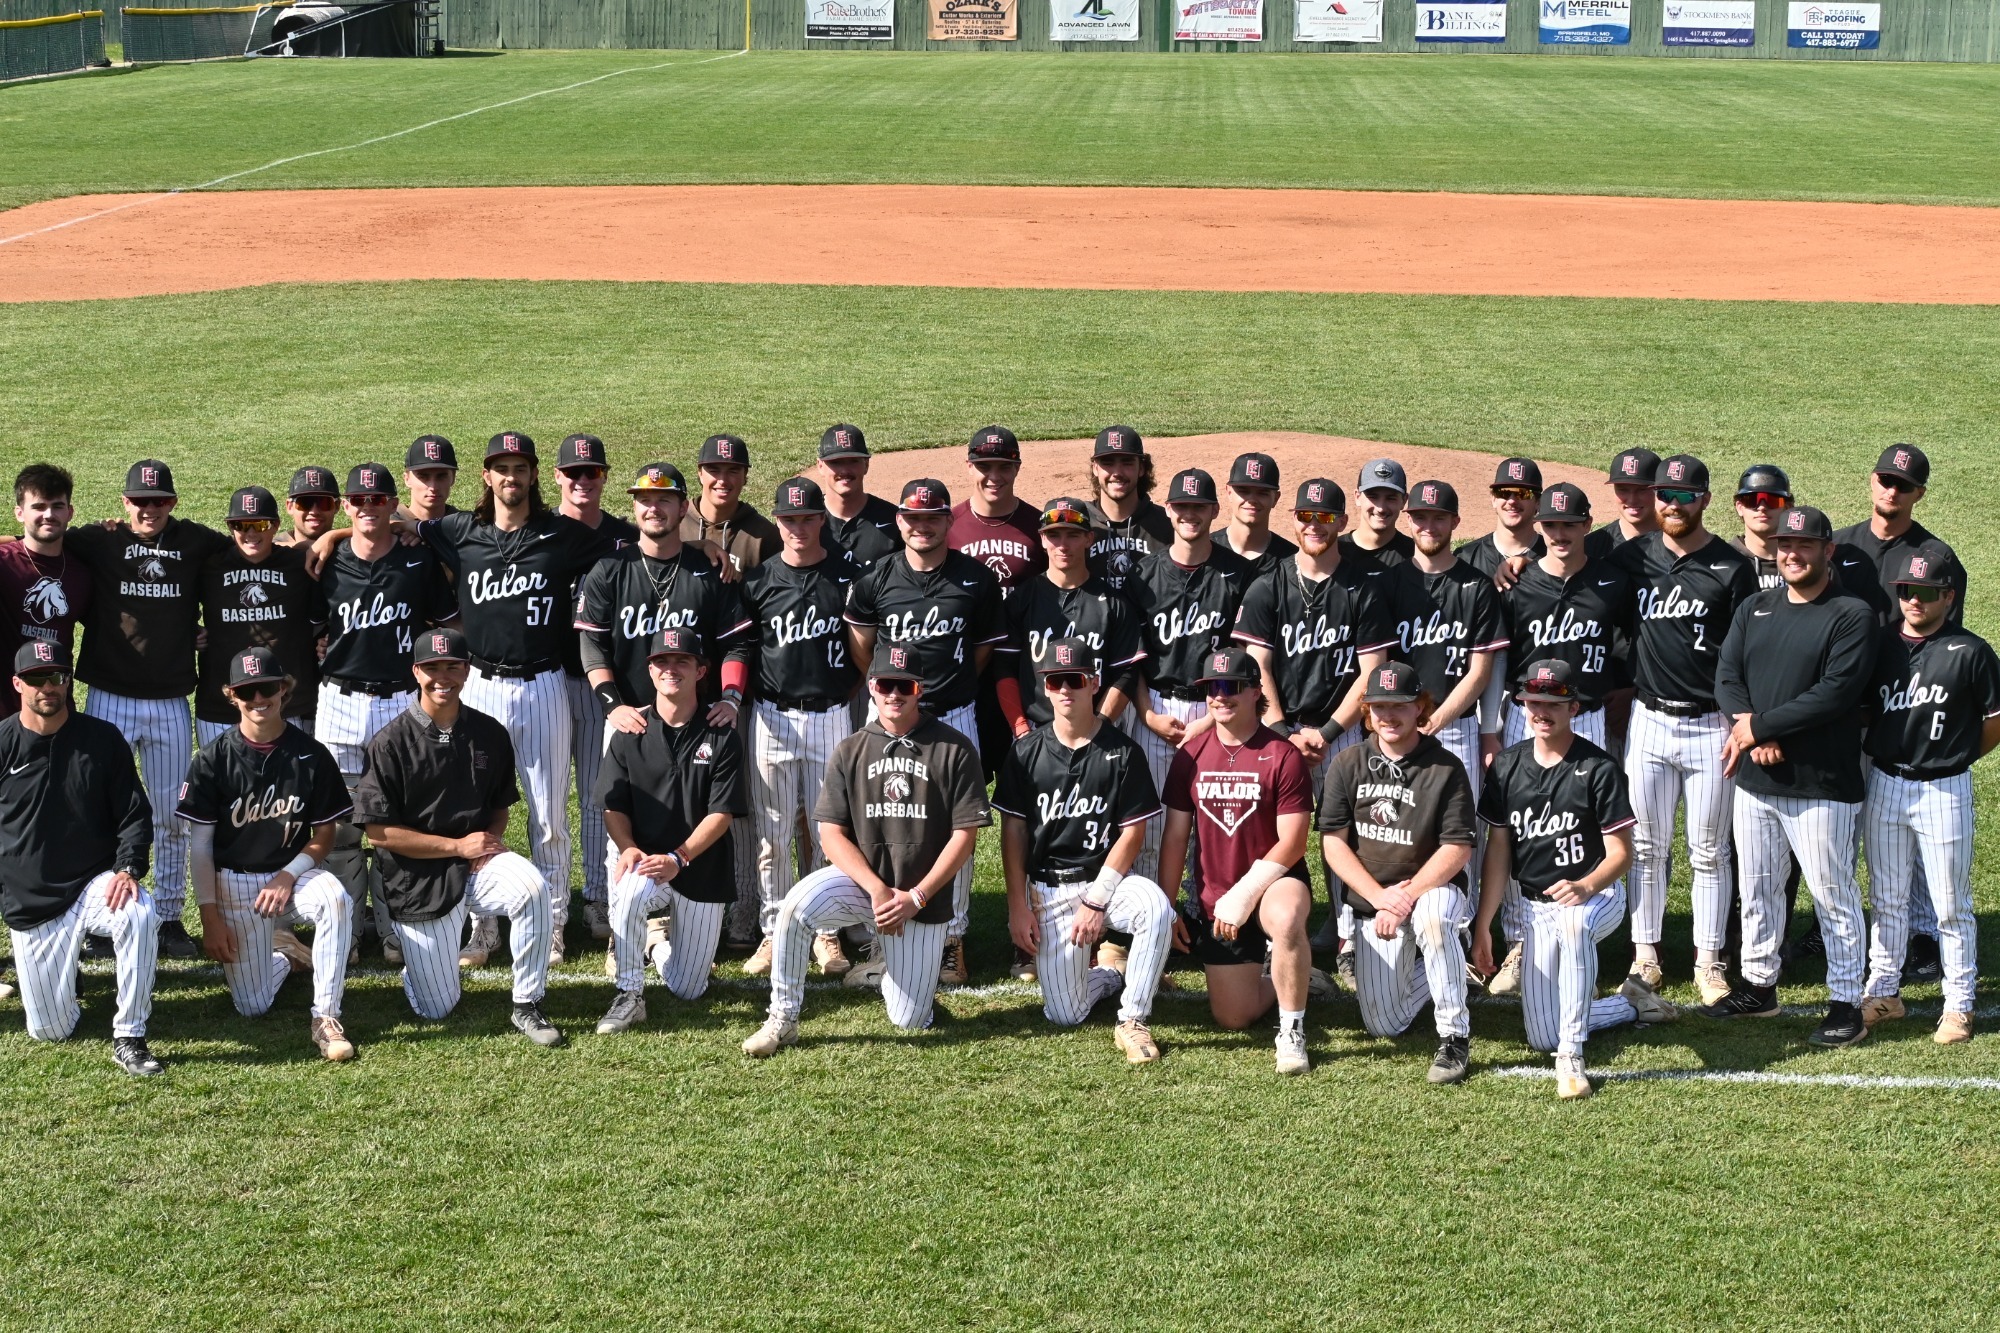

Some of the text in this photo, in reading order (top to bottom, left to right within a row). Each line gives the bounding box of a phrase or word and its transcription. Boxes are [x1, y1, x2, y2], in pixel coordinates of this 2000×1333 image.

[1568, 0, 1629, 8] MERRILL
[1825, 15, 1865, 23] ROOFING
[125, 543, 182, 561] EVANGEL
[960, 539, 1031, 562] EVANGEL
[1089, 537, 1151, 558] EVANGEL
[120, 581, 181, 598] BASEBALL
[223, 569, 287, 587] EVANGEL
[468, 563, 547, 604] Valor
[222, 605, 287, 622] BASEBALL
[338, 592, 411, 635] Valor
[526, 596, 554, 626] 57
[1637, 585, 1708, 620] Valor
[21, 624, 58, 641] BASEBALL
[620, 599, 698, 640] Valor
[771, 606, 841, 648] Valor
[886, 606, 966, 642] Valor
[1154, 602, 1226, 646] Valor
[1396, 610, 1468, 654] Valor
[1528, 607, 1603, 648] Valor
[396, 625, 412, 654] 14
[1281, 614, 1351, 658] Valor
[1694, 623, 1706, 651] 2
[827, 641, 845, 668] 12
[953, 638, 964, 664] 4
[1334, 648, 1355, 677] 22
[1581, 644, 1606, 674] 26
[1879, 672, 1948, 713] Valor
[439, 734, 450, 742] 22
[1930, 711, 1945, 740] 6
[867, 757, 929, 782] EVANGEL
[1037, 783, 1107, 826] Valor
[1196, 782, 1261, 800] VALOR
[1356, 784, 1416, 807] EVANGEL
[231, 784, 305, 828] Valor
[866, 803, 928, 819] BASEBALL
[282, 821, 303, 848] 17
[1083, 821, 1111, 851] 34
[1356, 821, 1413, 846] BASEBALL
[1510, 801, 1579, 842] Valor
[1554, 833, 1585, 867] 36
